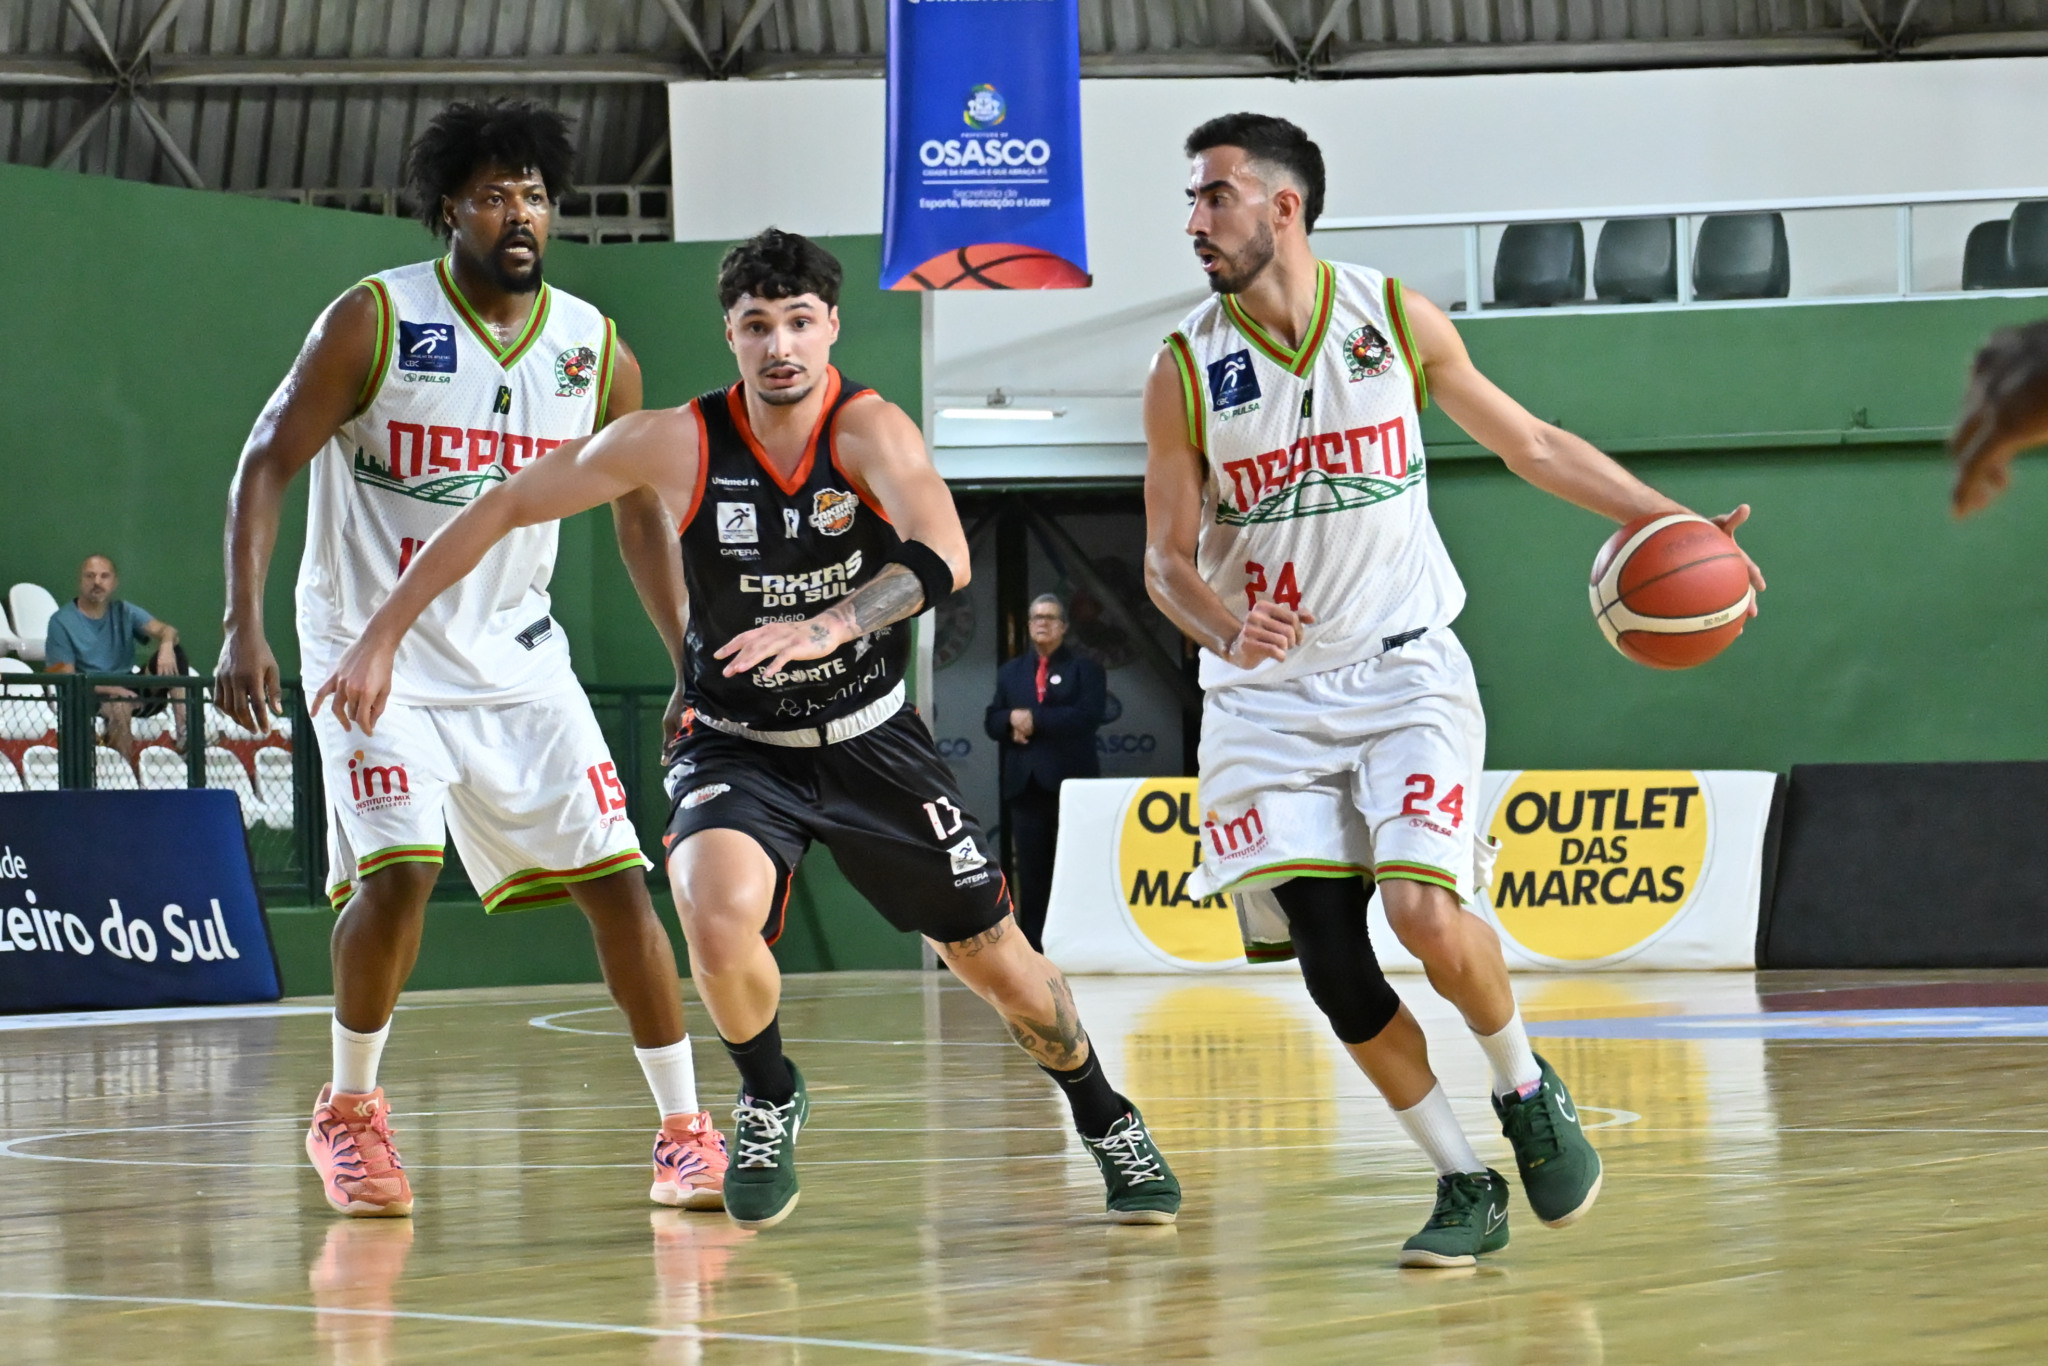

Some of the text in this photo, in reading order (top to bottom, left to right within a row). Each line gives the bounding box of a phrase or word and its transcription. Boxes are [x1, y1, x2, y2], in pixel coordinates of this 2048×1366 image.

[919, 139, 1050, 167] OSASCO
[1024, 197, 1051, 207] Lazer
[418, 374, 451, 383] PULSA
[1232, 402, 1261, 418] PULSA
[387, 420, 575, 480] OSAS
[1223, 416, 1407, 512] OSASCO
[712, 477, 749, 486] Unimed
[720, 548, 760, 556] CATERA
[740, 550, 862, 593] CAXIAS
[1245, 561, 1302, 611] 24
[763, 582, 855, 607] DO SUL
[755, 613, 805, 626] PEDÁGIO
[348, 758, 408, 801] im
[587, 761, 627, 815] 15
[356, 796, 392, 810] INSTITUTO
[1138, 791, 1200, 836] OU
[1400, 773, 1464, 828] 24
[1506, 787, 1699, 834] OUTLET
[1204, 807, 1263, 856] im
[1560, 835, 1627, 866] DAS
[0, 845, 28, 879] de
[954, 871, 989, 887] CATERA
[1495, 865, 1685, 908] MARCAS
[100, 898, 158, 962] do
[162, 898, 240, 962] Sul
